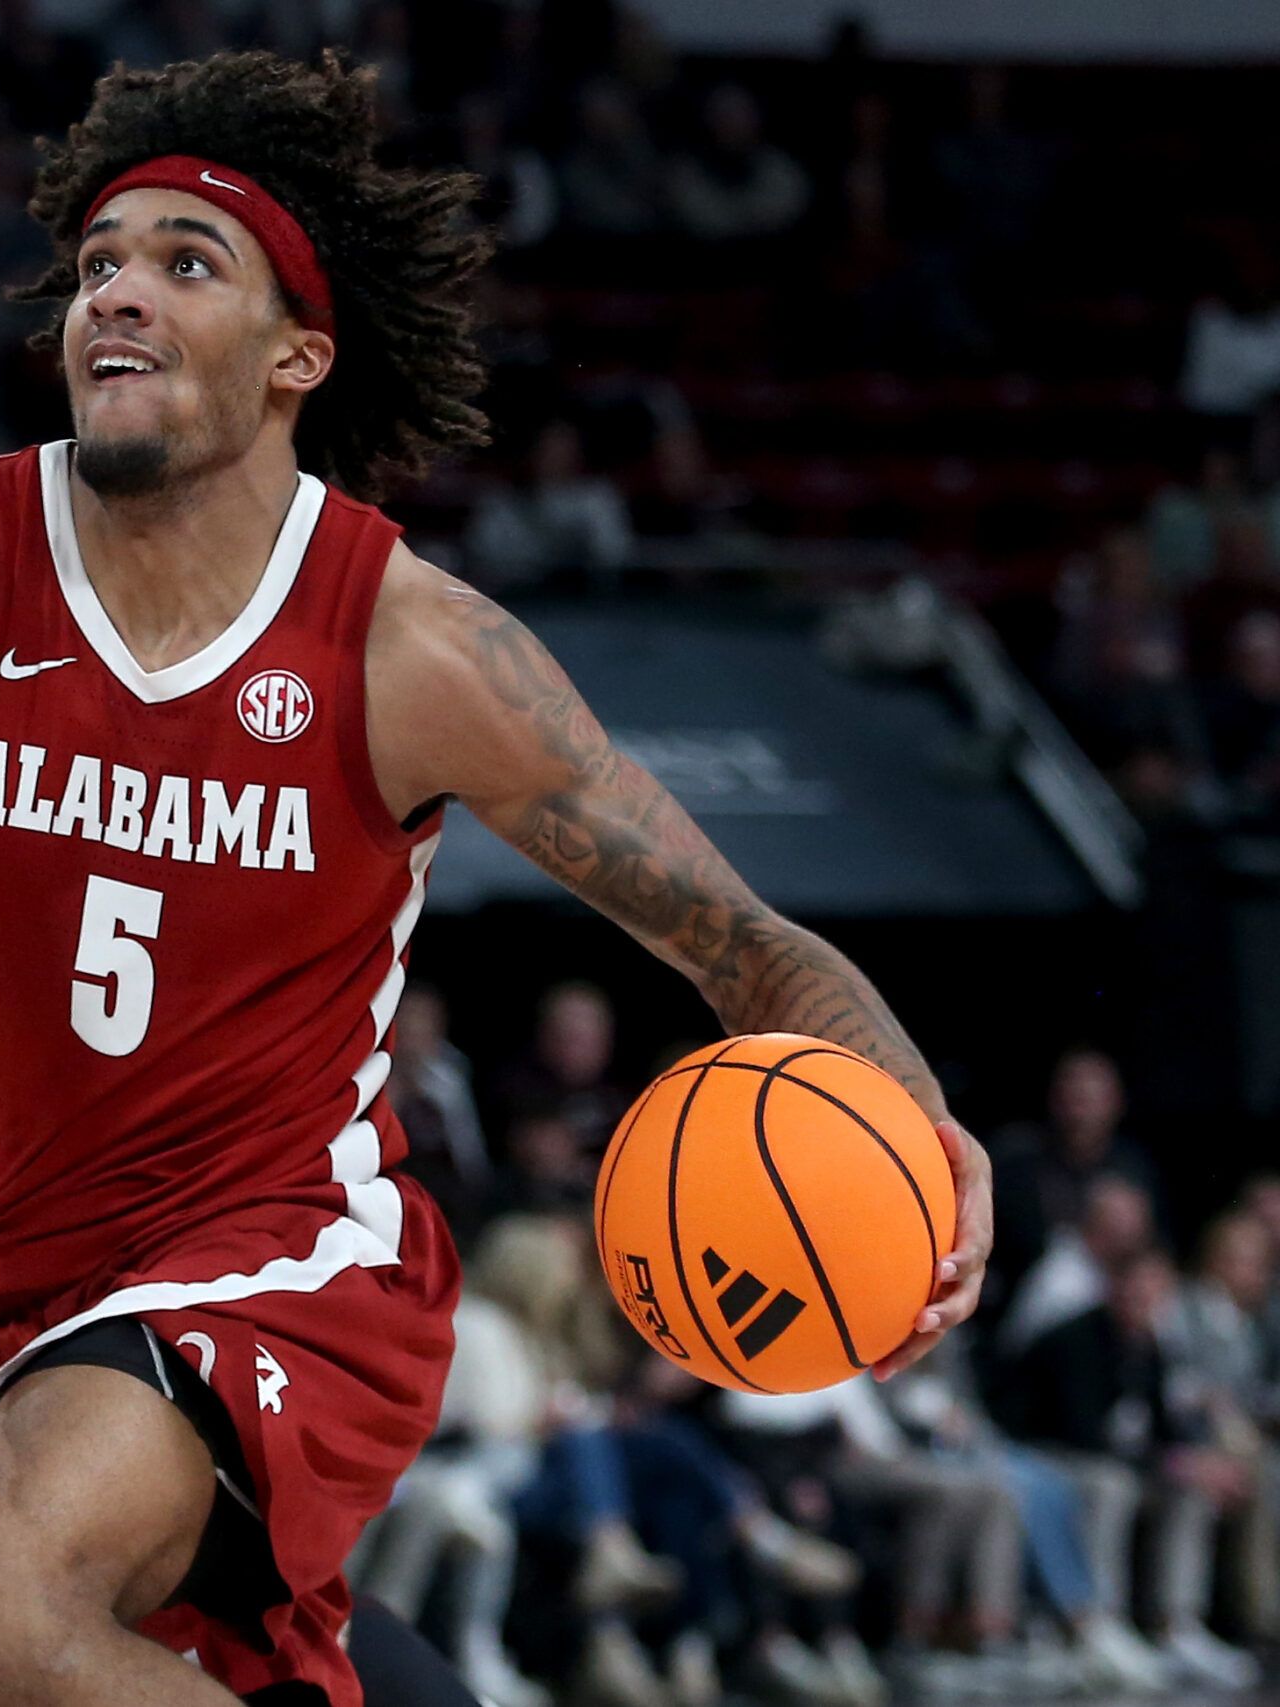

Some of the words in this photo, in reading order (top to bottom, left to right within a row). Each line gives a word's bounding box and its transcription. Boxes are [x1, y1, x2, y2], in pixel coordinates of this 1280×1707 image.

[245, 675, 307, 738] SEC
[70, 873, 164, 1058] 5
[625, 1253, 691, 1360] PRO
